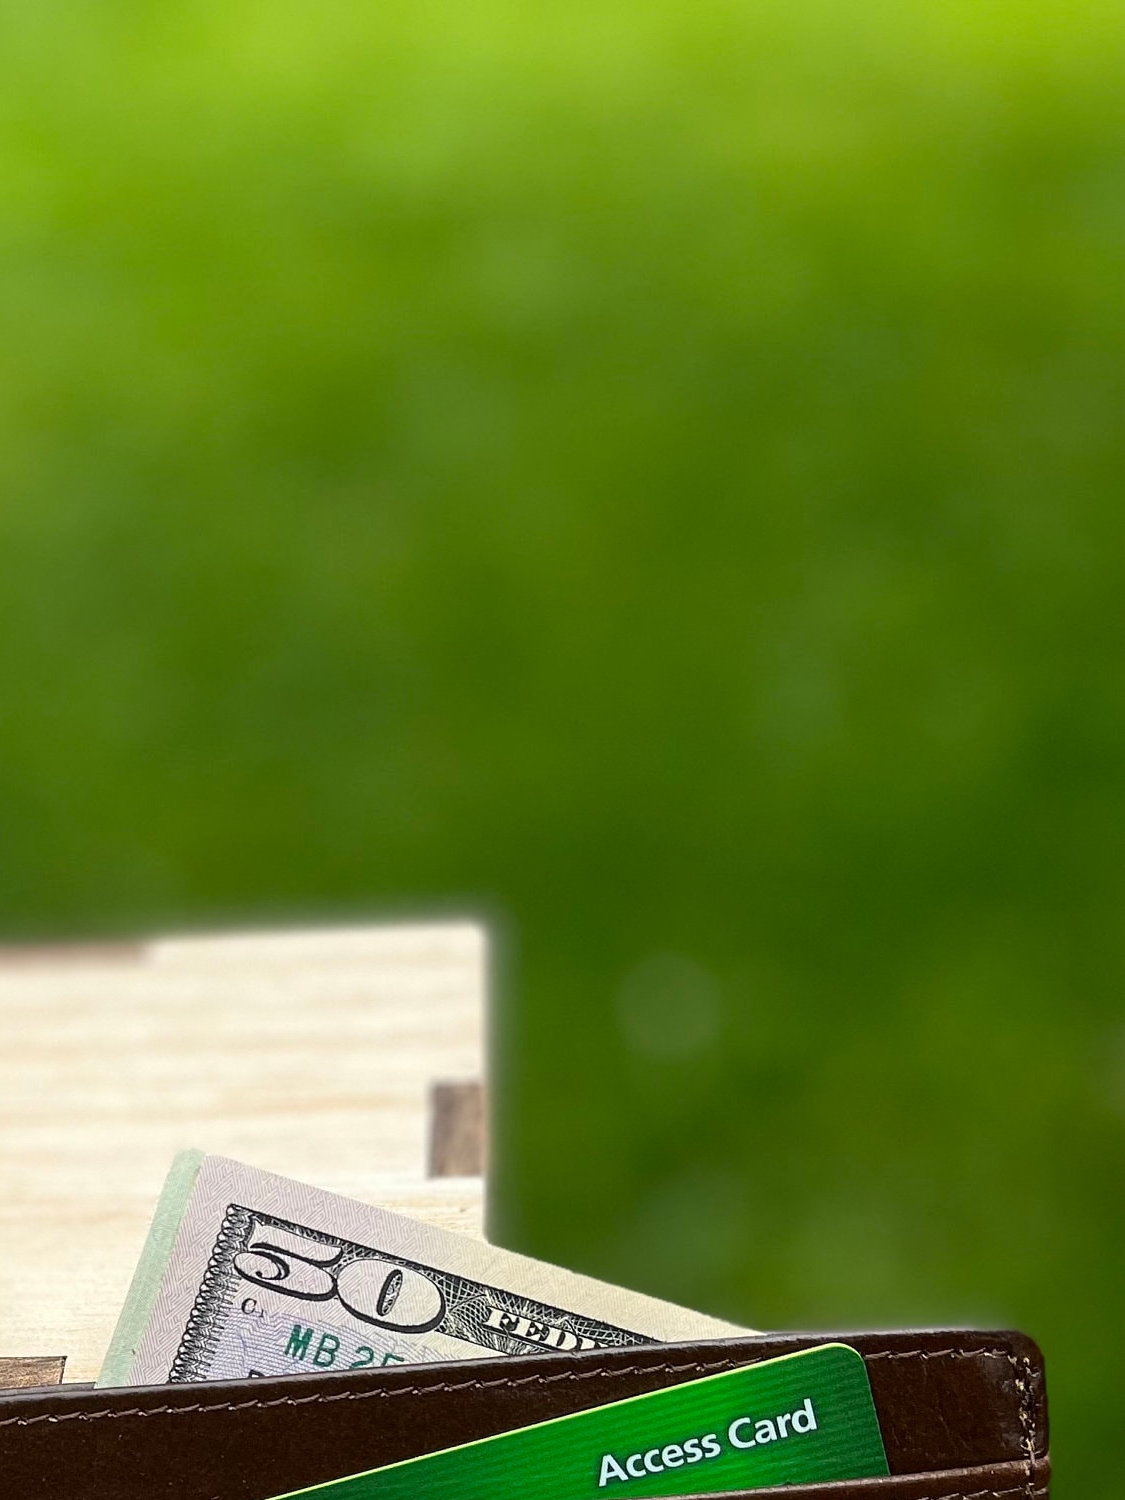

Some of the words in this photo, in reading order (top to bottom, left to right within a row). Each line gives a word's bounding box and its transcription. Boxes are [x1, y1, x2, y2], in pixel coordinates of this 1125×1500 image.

[234, 1216, 446, 1334] 50
[598, 1433, 721, 1487] Access
[727, 1398, 818, 1449] Card
